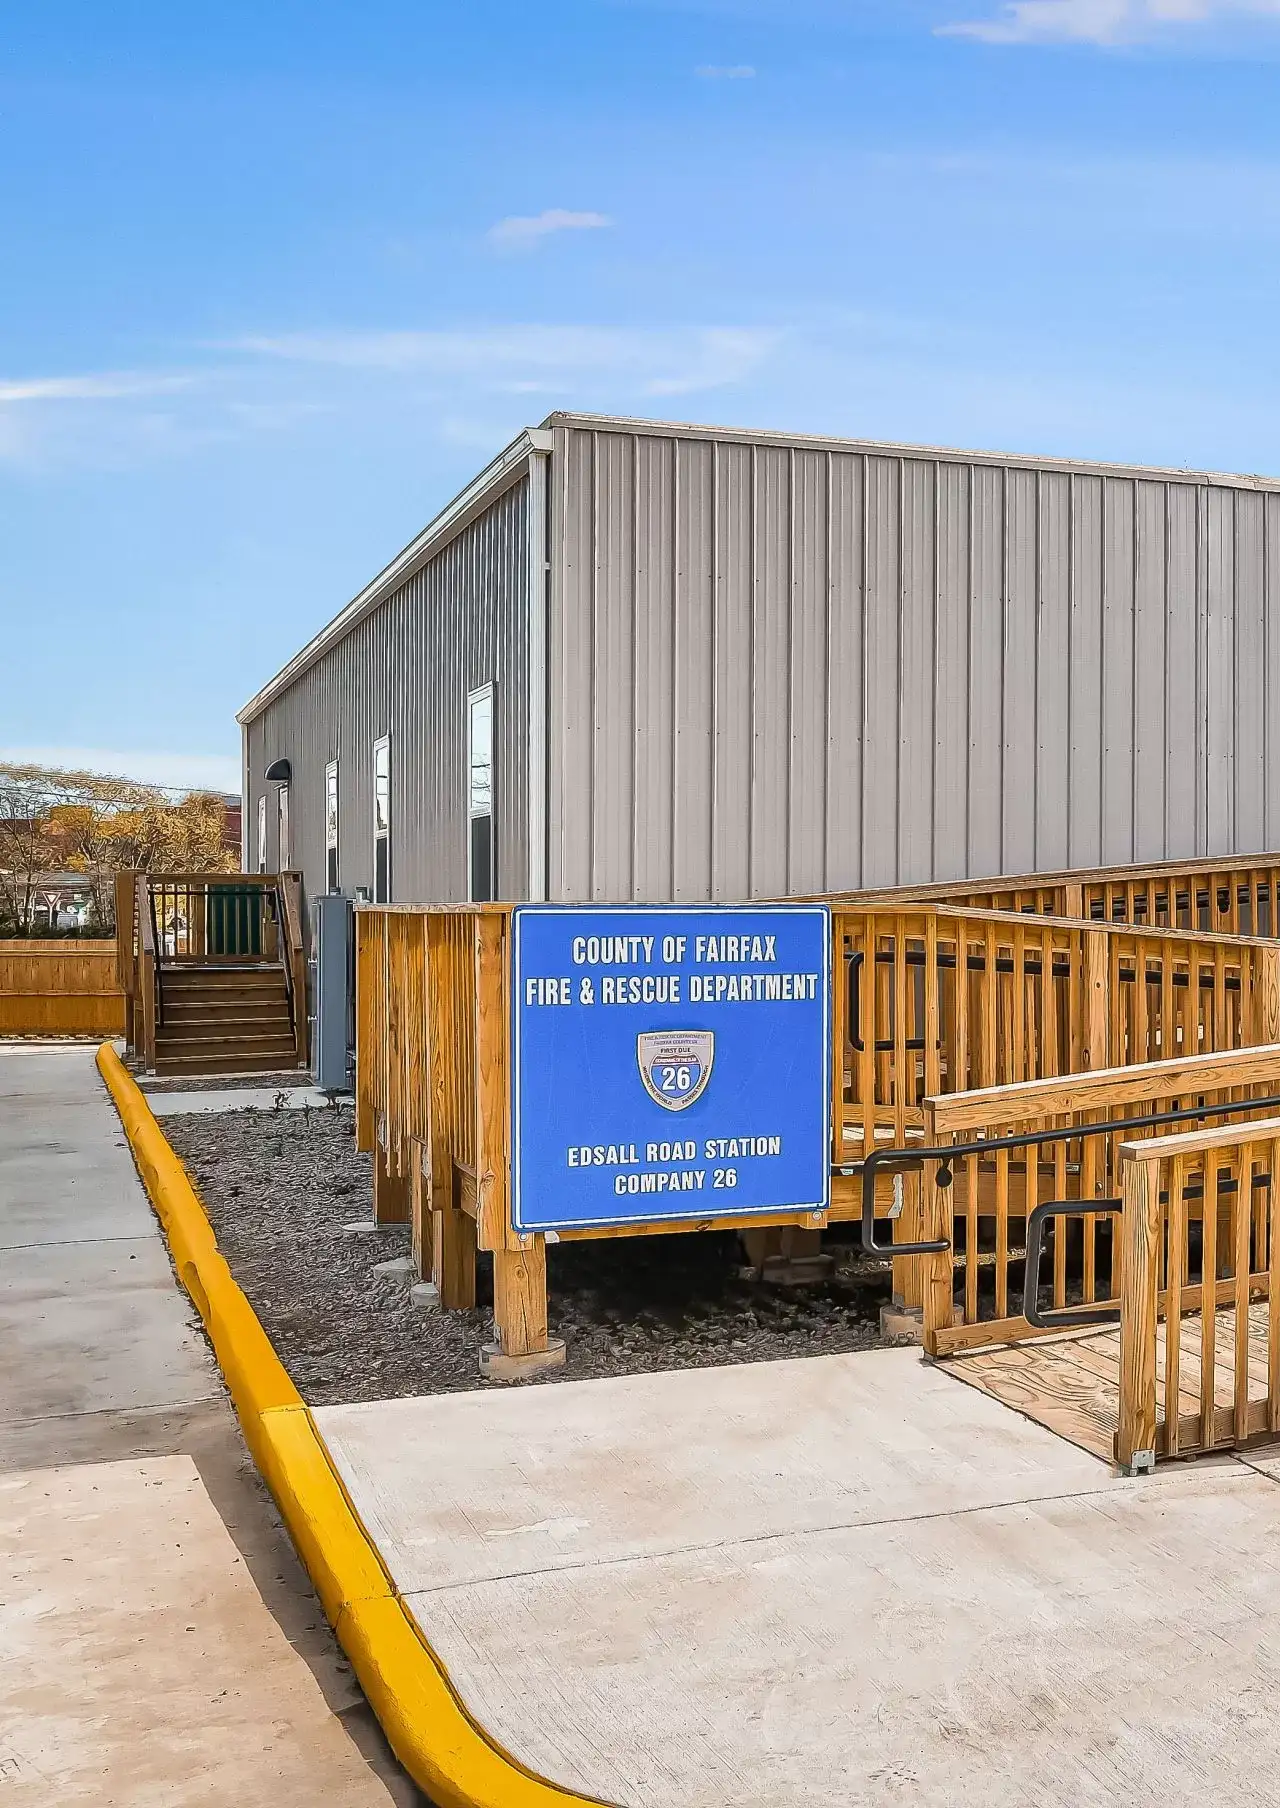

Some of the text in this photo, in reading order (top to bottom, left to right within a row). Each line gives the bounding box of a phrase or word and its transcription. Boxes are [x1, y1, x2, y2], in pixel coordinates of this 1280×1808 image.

[572, 935, 776, 964] COUNTY OF FAIRFAX
[526, 974, 818, 1005] FIRE & RESCUE DEPARTMENT
[662, 1066, 691, 1091] 26
[568, 1136, 781, 1167] EDSALL ROAD STATION
[614, 1168, 737, 1195] COMPANY 26
